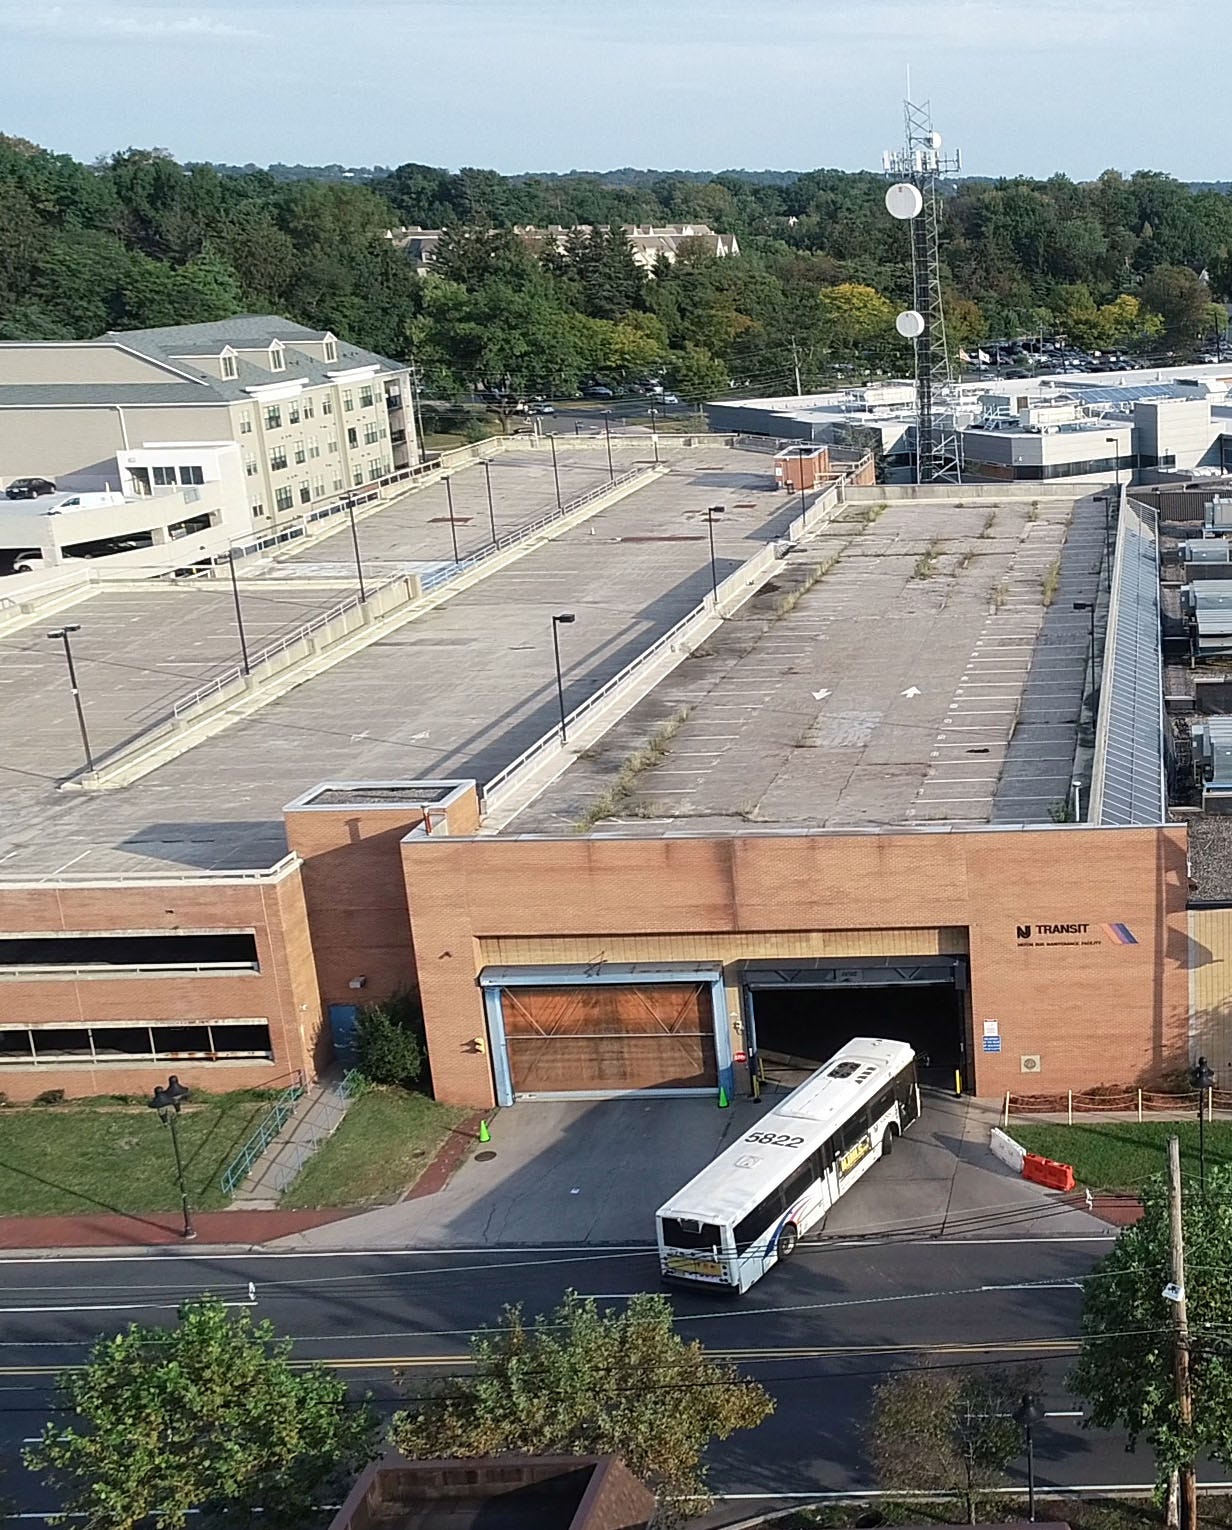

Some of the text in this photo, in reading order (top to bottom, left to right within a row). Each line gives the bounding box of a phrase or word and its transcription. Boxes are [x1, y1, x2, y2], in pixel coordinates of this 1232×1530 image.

[1017, 924, 1090, 938] NJ TRANSIT
[745, 1132, 804, 1148] 5822
